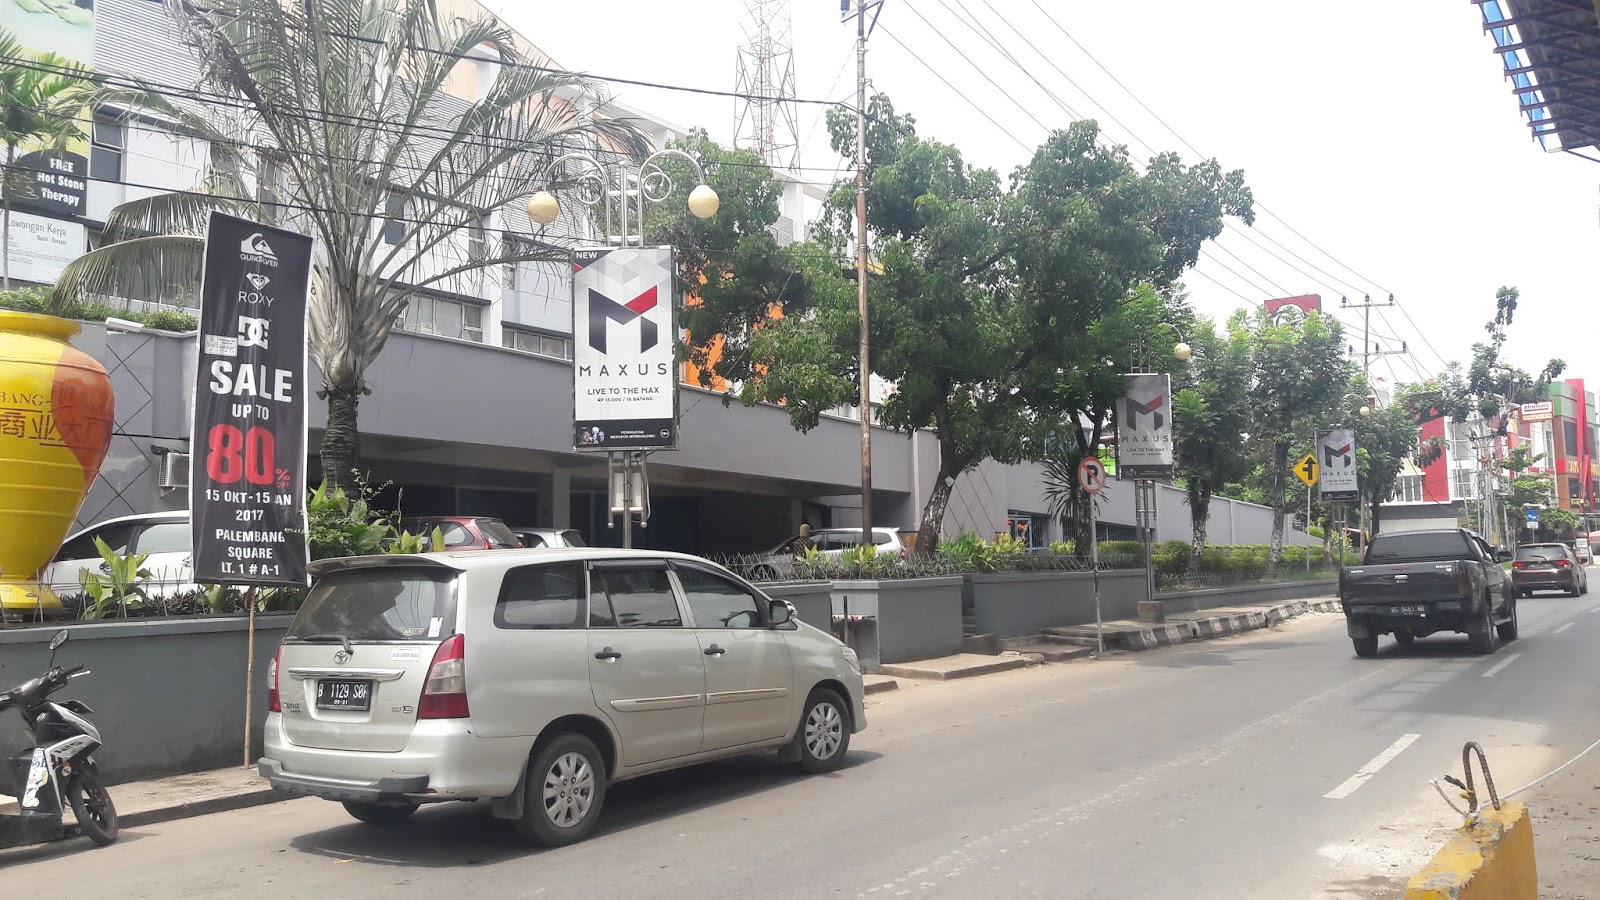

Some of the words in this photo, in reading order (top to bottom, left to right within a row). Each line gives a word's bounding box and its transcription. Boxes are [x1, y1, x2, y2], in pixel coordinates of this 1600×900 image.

[50, 158, 74, 173] FREE
[37, 172, 55, 185] Hot
[58, 175, 84, 190] Stone
[41, 187, 80, 206] Therapy
[47, 223, 67, 237] Kerja
[576, 251, 597, 259] NEW
[238, 291, 274, 308] ROXY
[579, 362, 667, 377] MAXUS
[210, 360, 293, 403] SALE
[608, 387, 620, 395] TO
[641, 386, 660, 394] MAX
[231, 403, 252, 419] UP
[255, 404, 270, 420] TO
[1121, 435, 1169, 443] MAXUS
[206, 423, 275, 485] 80
[205, 488, 220, 501] 15
[235, 509, 264, 522] 2017
[215, 528, 286, 543] PALEMBANG
[228, 546, 273, 560] SQUARE
[221, 561, 235, 574] LT.
[239, 563, 244, 574] 1
[261, 564, 279, 576] A-1
[318, 683, 324, 698] B
[331, 683, 350, 699] 1129
